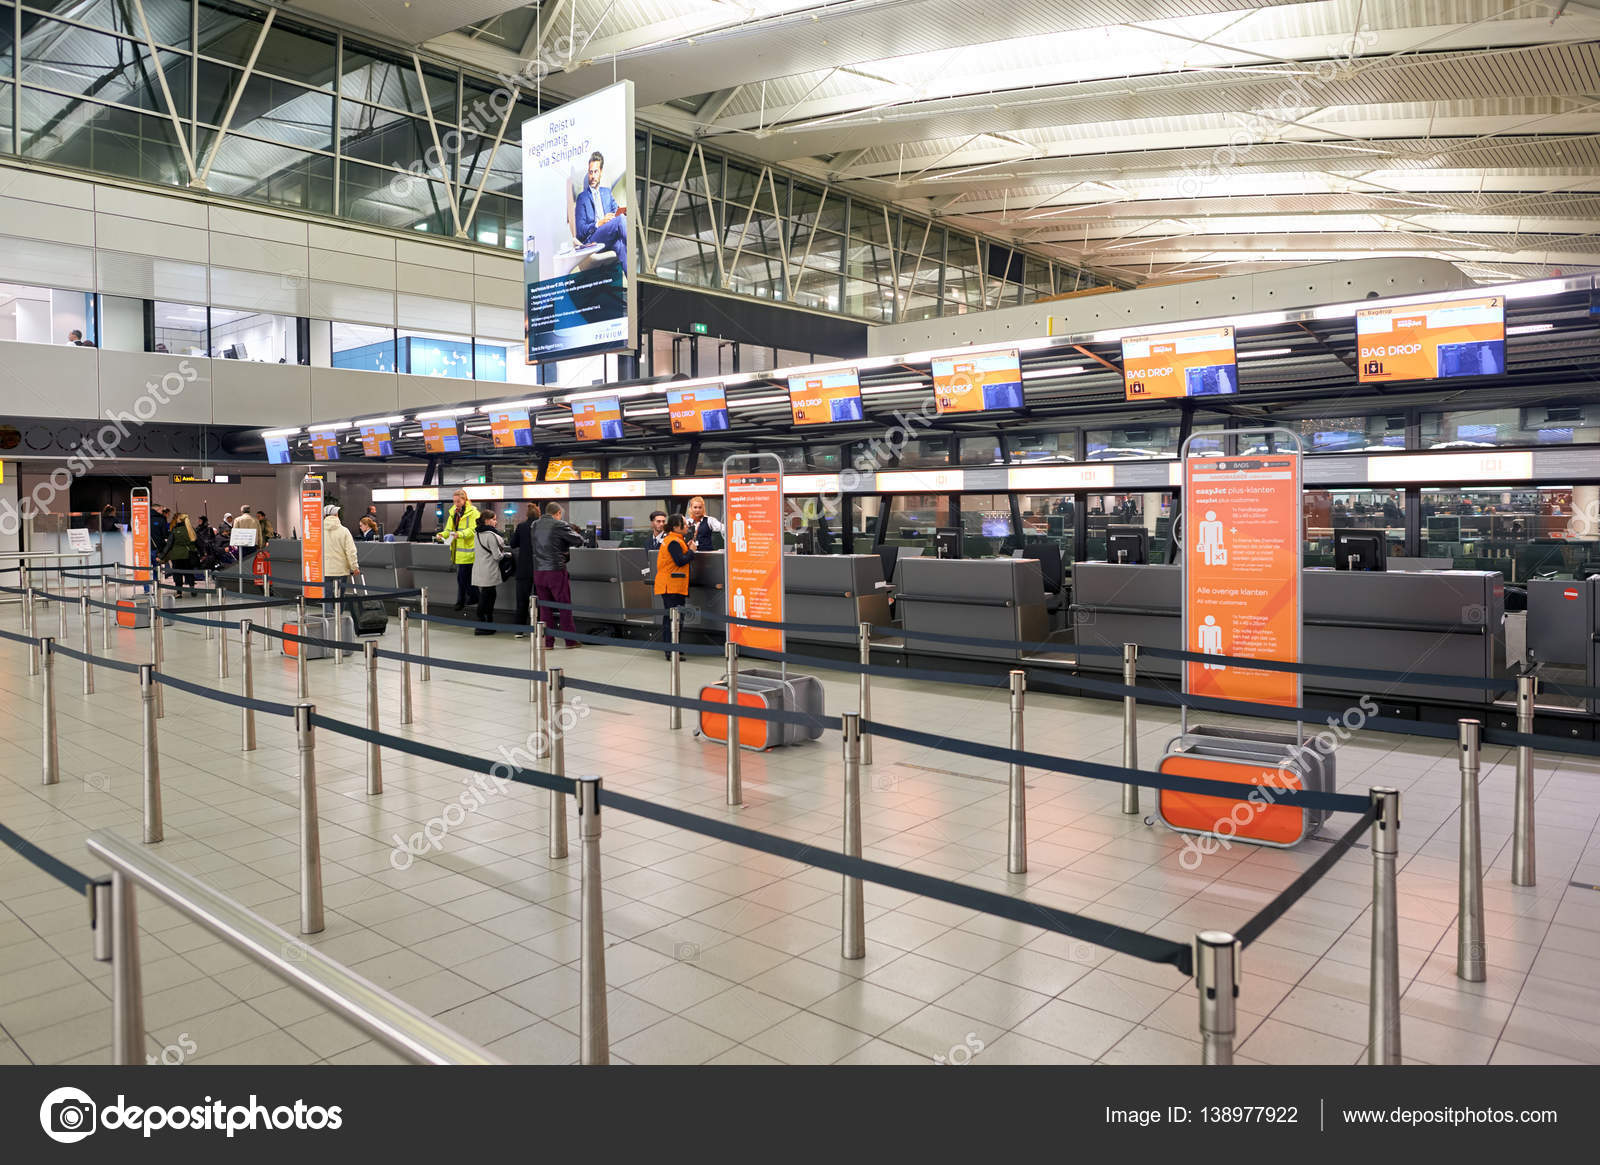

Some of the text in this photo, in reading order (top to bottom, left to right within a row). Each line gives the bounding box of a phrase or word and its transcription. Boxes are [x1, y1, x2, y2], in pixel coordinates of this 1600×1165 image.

[549, 118, 575, 134] Reist u
[528, 134, 568, 157] regelmatig
[540, 140, 590, 168] via Schiphol?
[1490, 298, 1498, 307] 2
[594, 330, 622, 340] PRIVIUM
[1224, 328, 1229, 336] 3
[1361, 344, 1422, 358] BAG DROP
[1127, 368, 1174, 378] BAG DROP
[952, 384, 972, 392] DROP
[806, 398, 822, 406] DROP
[1228, 486, 1275, 495] plus-klanten
[1212, 588, 1238, 597] overige
[1240, 588, 1268, 596] klanten
